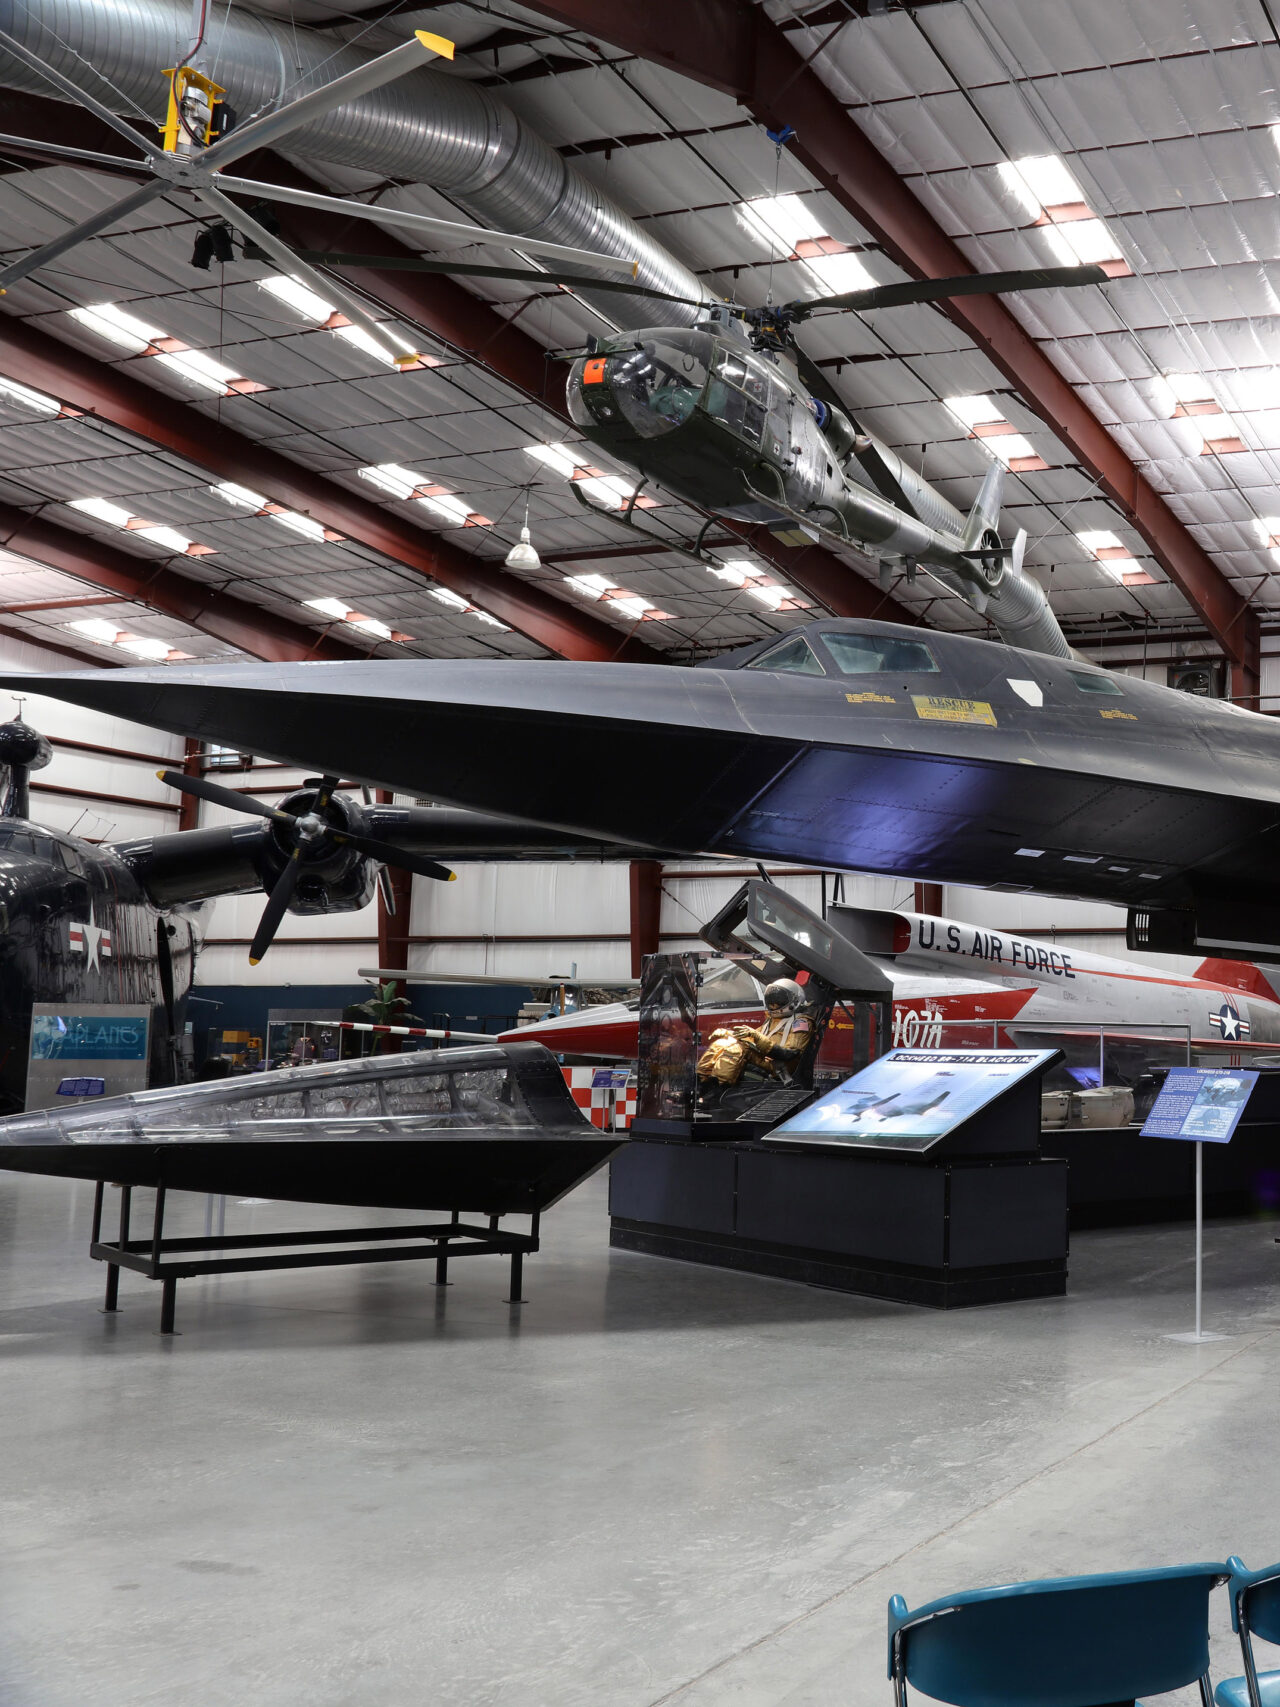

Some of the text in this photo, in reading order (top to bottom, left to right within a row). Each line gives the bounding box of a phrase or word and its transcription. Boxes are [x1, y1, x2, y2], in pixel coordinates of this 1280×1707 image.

[928, 697, 976, 710] RESCUE
[918, 919, 1076, 979] U.S. AIR FORCE
[893, 1009, 943, 1049] 107A
[890, 1053, 935, 1062] LOCKHEED
